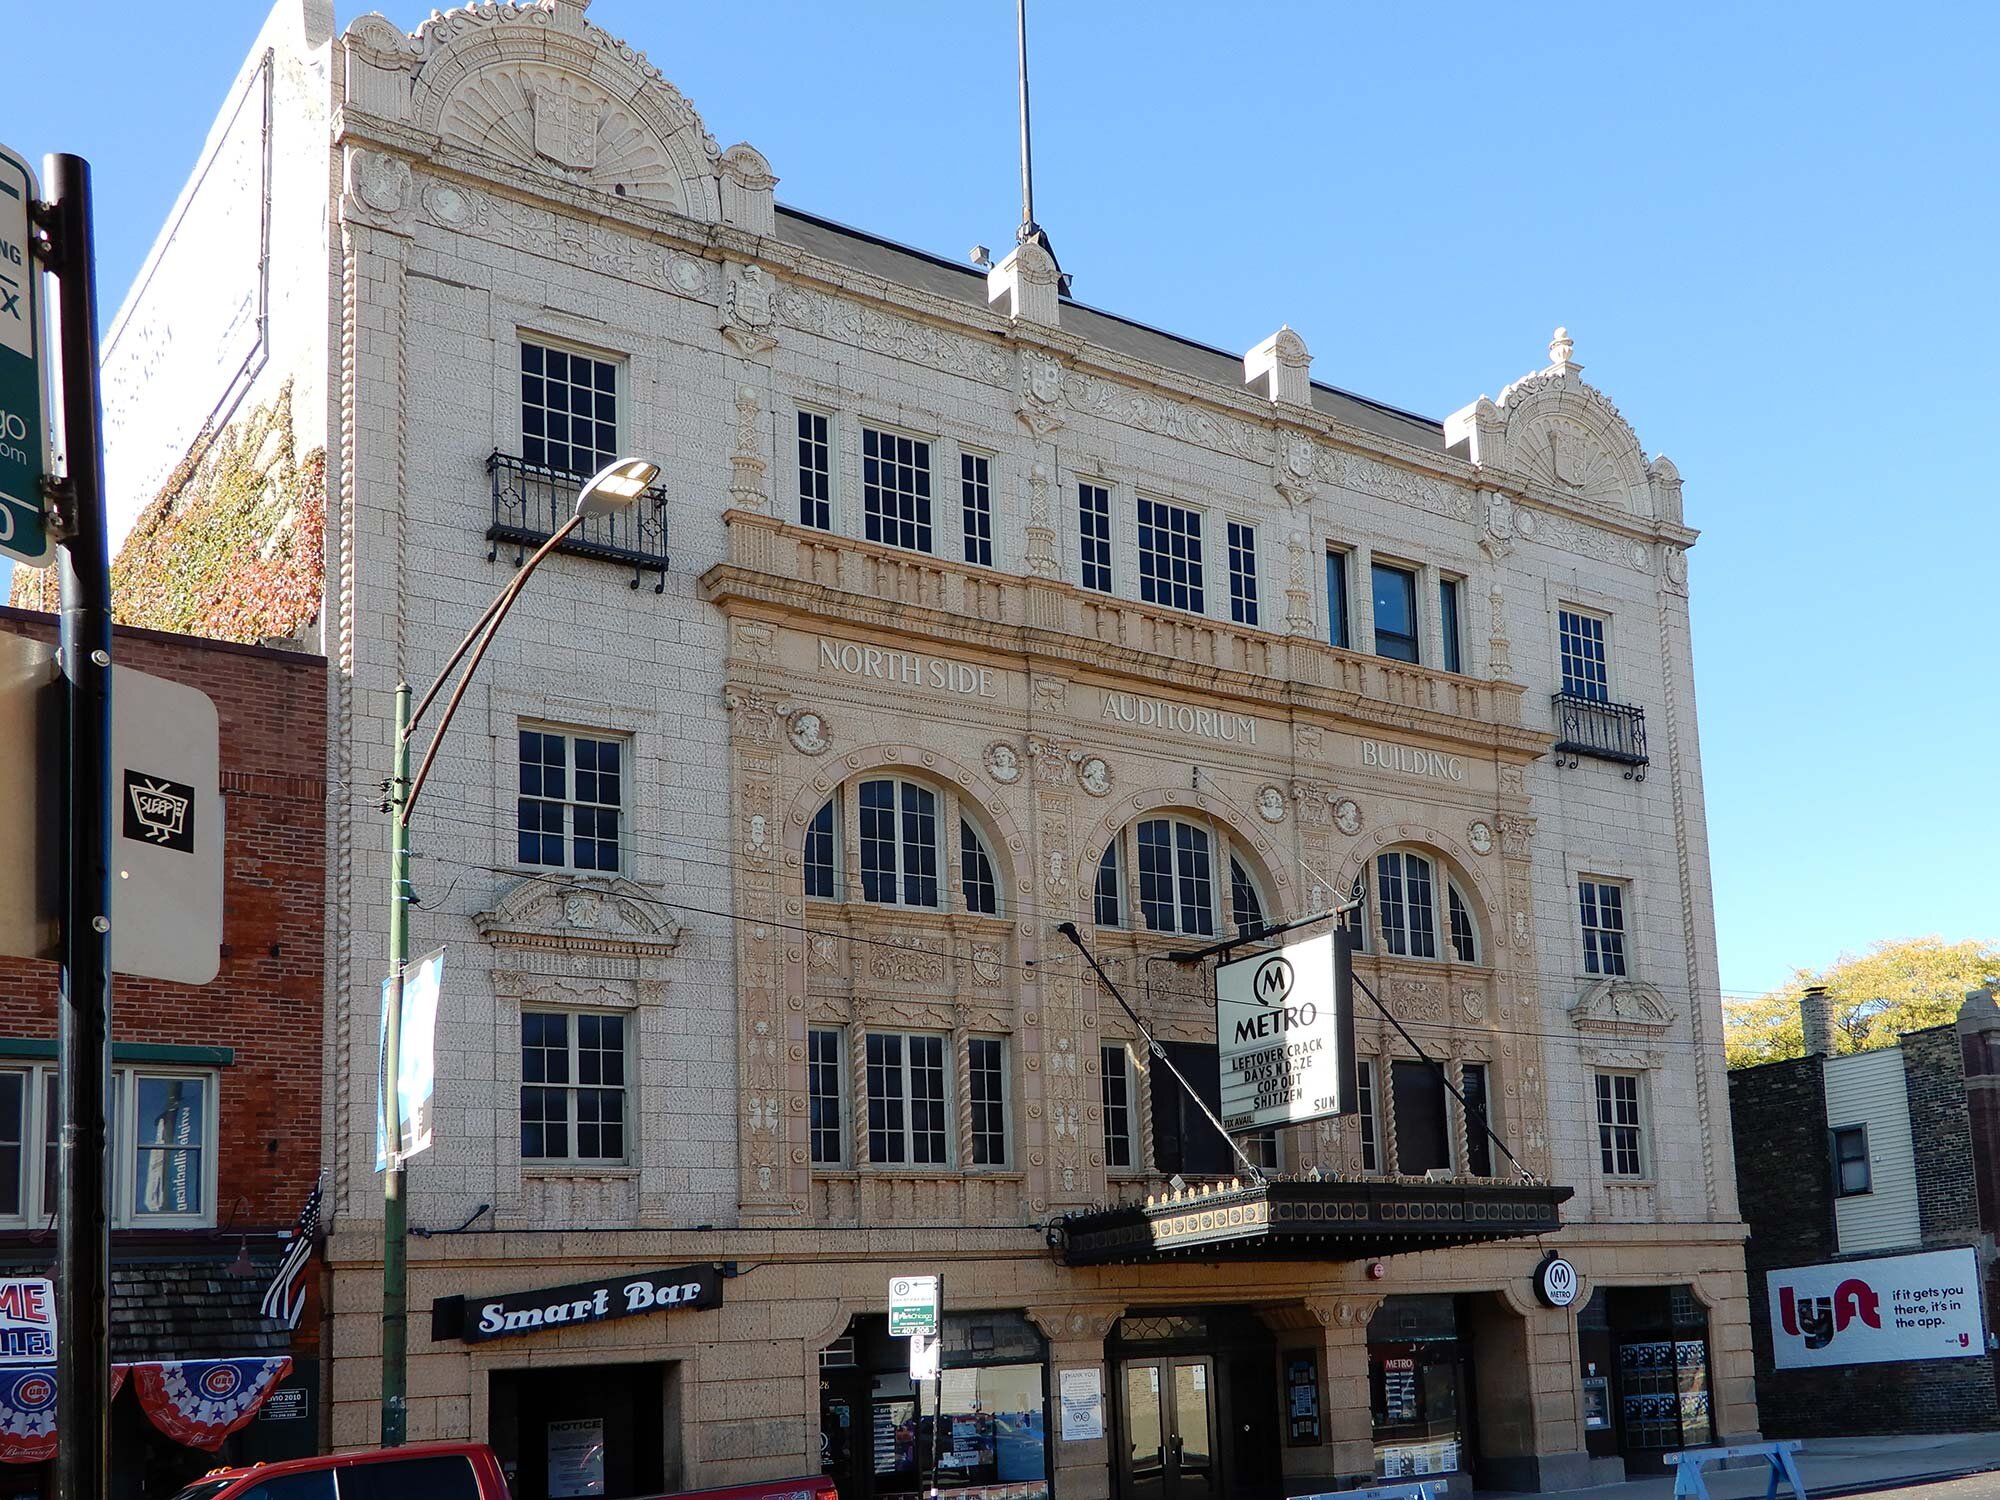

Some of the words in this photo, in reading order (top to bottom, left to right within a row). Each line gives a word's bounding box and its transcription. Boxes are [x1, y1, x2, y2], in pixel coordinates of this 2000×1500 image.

[819, 639, 922, 686] NORTH
[928, 659, 998, 699] SIDE
[1102, 692, 1257, 745] AUDITORIUM
[1362, 740, 1462, 781] BUILDING
[139, 795, 174, 818] SLEEP
[1262, 966, 1285, 995] M
[1234, 1002, 1317, 1044] METRO
[1232, 1047, 1284, 1071] LEFTOVER
[1287, 1037, 1323, 1058] CRACK
[1244, 1063, 1272, 1082] DAYS
[1276, 1061, 1283, 1076] N
[1286, 1055, 1312, 1074] DAZE
[1257, 1077, 1277, 1094] COP
[1281, 1073, 1302, 1089] OUT
[1253, 1088, 1303, 1110] SHITIZEN
[1314, 1095, 1336, 1111] SUN
[1554, 1269, 1566, 1283] M
[1892, 1290, 1901, 1301] if
[1902, 1289, 1911, 1299] it
[1913, 1289, 1939, 1301] gets
[1942, 1287, 1964, 1298] you
[479, 1288, 609, 1333] Smart
[623, 1281, 701, 1310] Bar
[1779, 1278, 1881, 1349] lyft
[1894, 1305, 1929, 1316] there,
[1931, 1301, 1948, 1312] it's
[1949, 1300, 1961, 1311] in
[1896, 1318, 1917, 1328] the
[1918, 1317, 1945, 1328] app.
[1386, 1359, 1412, 1369] METRO
[551, 1420, 601, 1432] NOTICE
